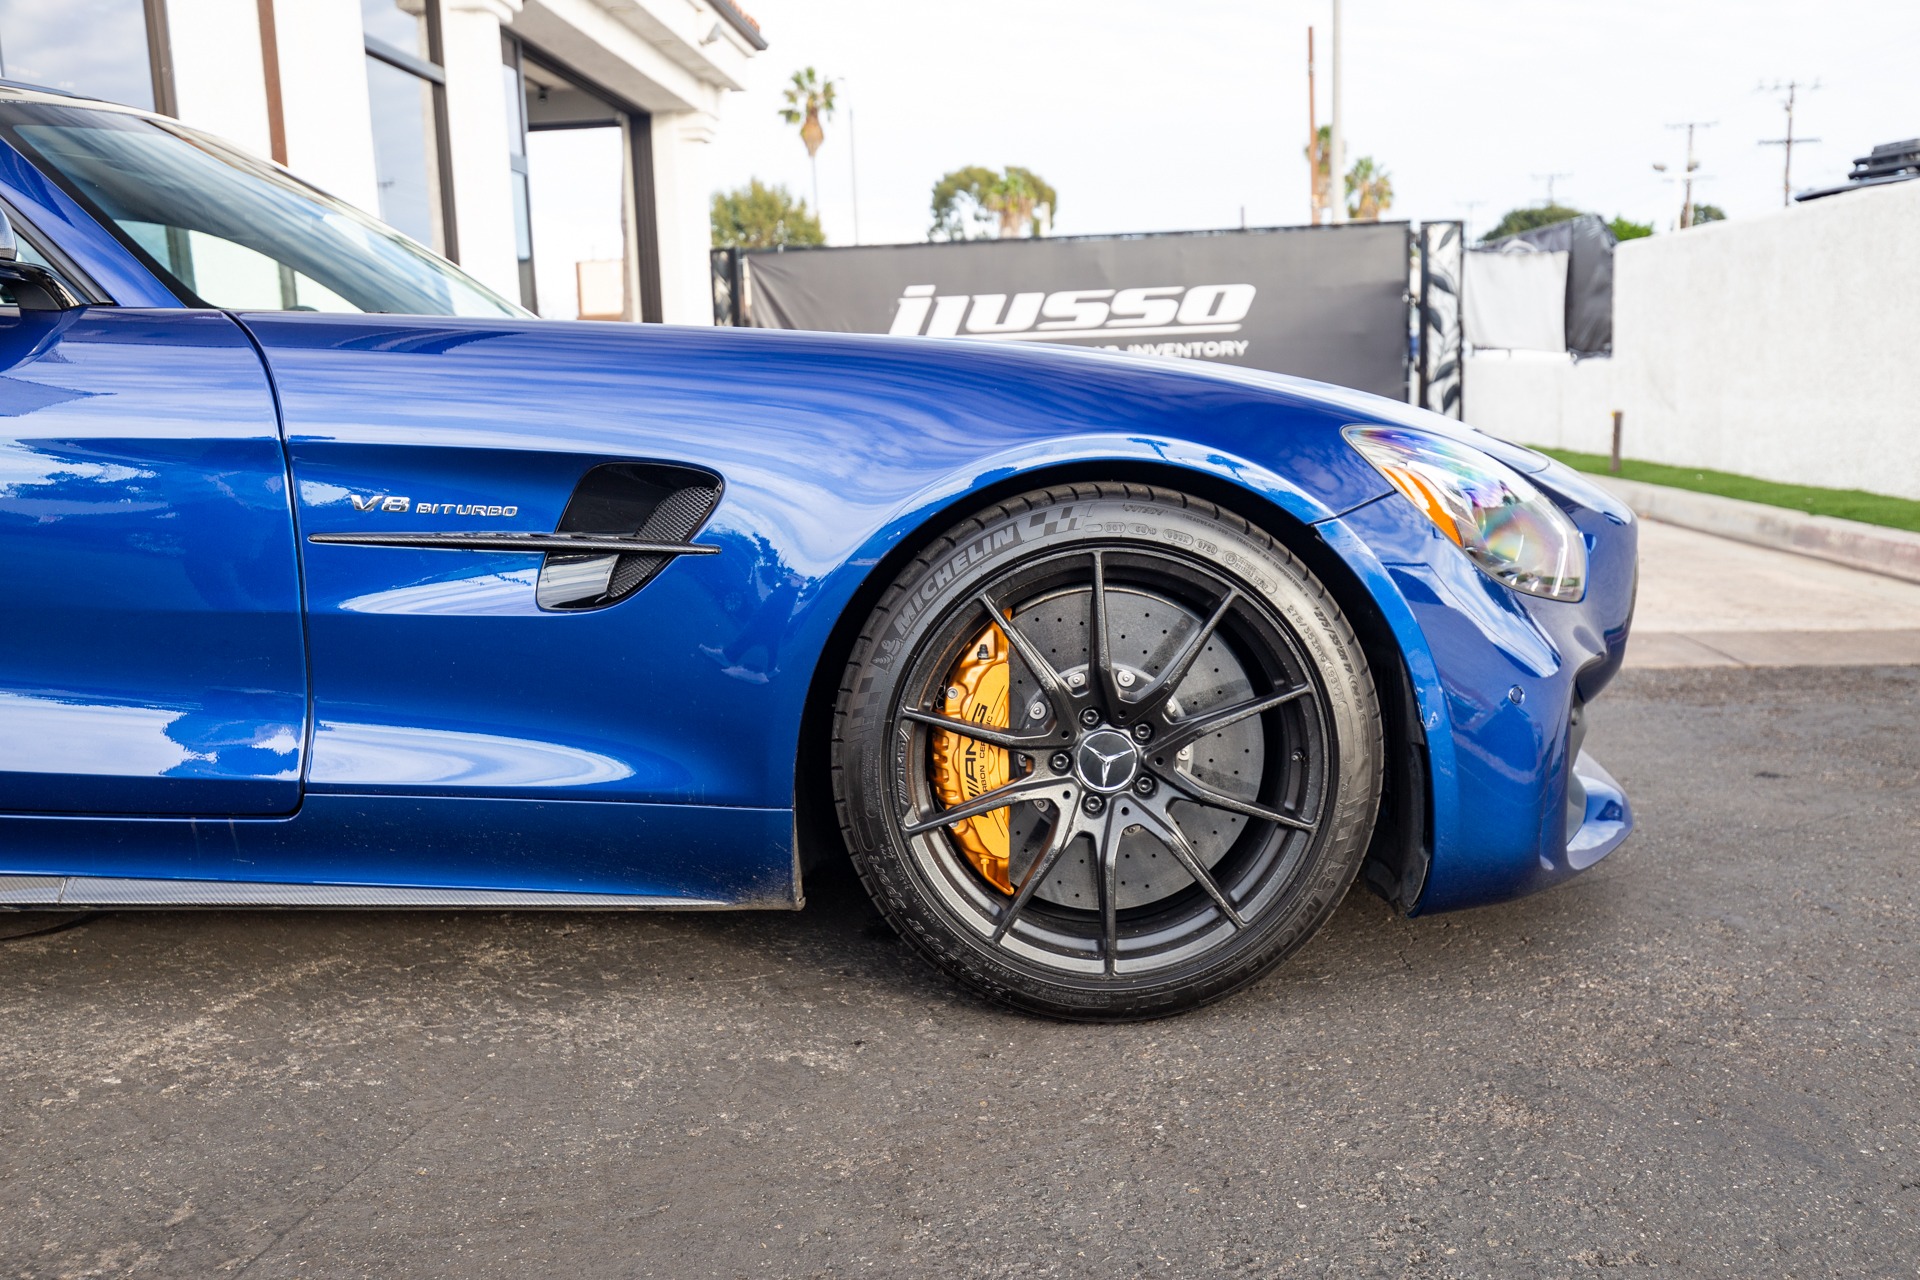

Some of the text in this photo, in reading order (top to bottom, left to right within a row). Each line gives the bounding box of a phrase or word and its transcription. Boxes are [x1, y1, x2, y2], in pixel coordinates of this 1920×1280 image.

[351, 494, 518, 517] V8 BITURBO
[893, 525, 1015, 633] MICHELIN
[864, 850, 909, 914] Sport
